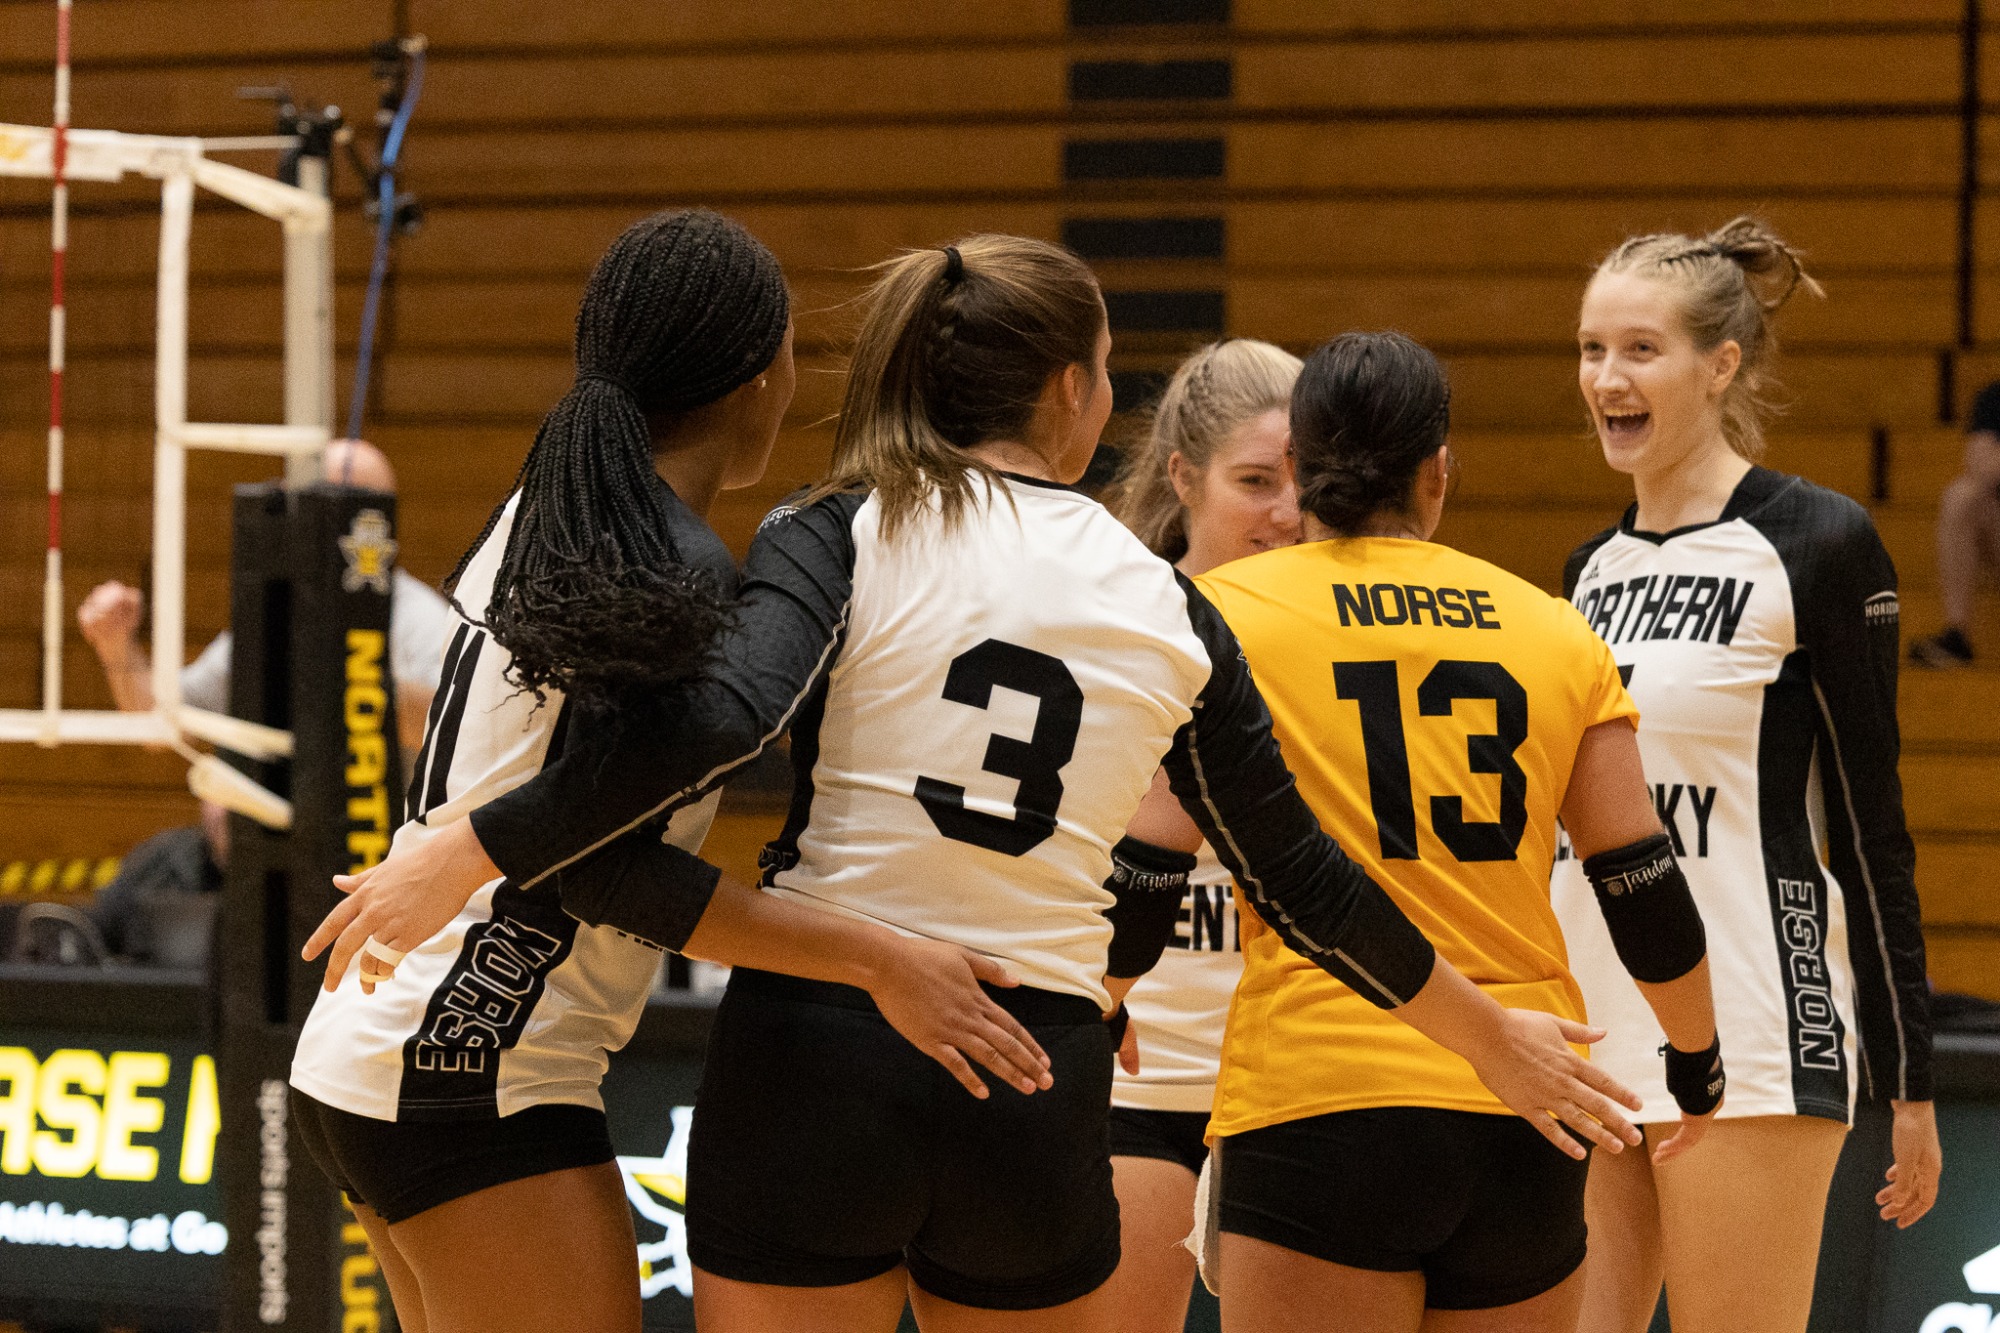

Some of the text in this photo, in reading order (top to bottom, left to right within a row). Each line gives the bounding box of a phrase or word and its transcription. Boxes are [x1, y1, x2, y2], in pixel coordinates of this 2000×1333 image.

[1332, 584, 1501, 629] NORSE
[913, 638, 1084, 857] 3
[1332, 660, 1528, 862] 13
[1602, 855, 1674, 894] Tandem
[416, 916, 562, 1073] NORSE
[1778, 878, 1839, 1071] NORSE
